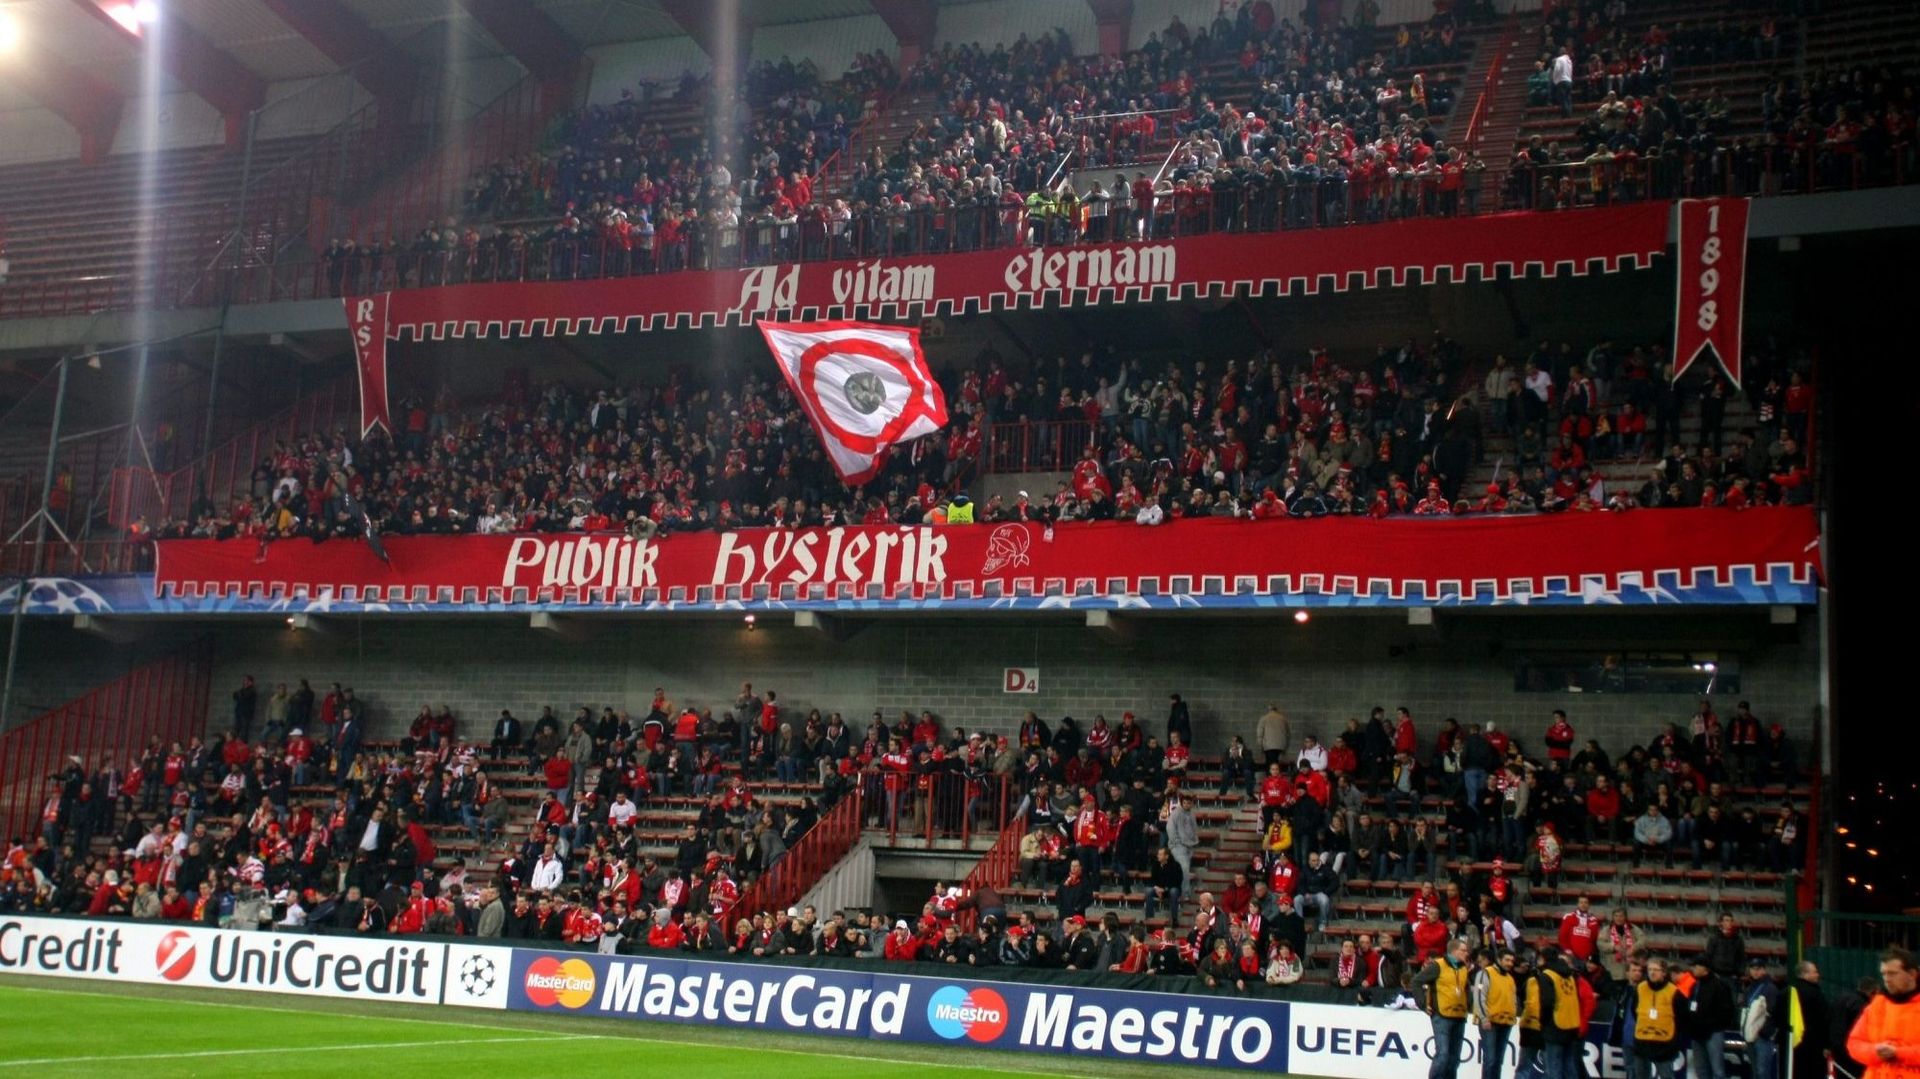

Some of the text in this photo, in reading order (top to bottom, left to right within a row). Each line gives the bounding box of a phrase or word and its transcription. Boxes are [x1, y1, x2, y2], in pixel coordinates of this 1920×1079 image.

[728, 244, 1175, 311] Ad vitam eternam
[1698, 205, 1721, 331] 1898
[502, 536, 660, 588] Publik
[1006, 669, 1036, 692] D4
[0, 920, 122, 974] Credit
[209, 934, 429, 998] UniCredit
[526, 973, 593, 992] MasterCard
[601, 961, 910, 1035] MasterCard
[935, 1003, 1001, 1024] Maestro
[1020, 992, 1273, 1065] Maestro
